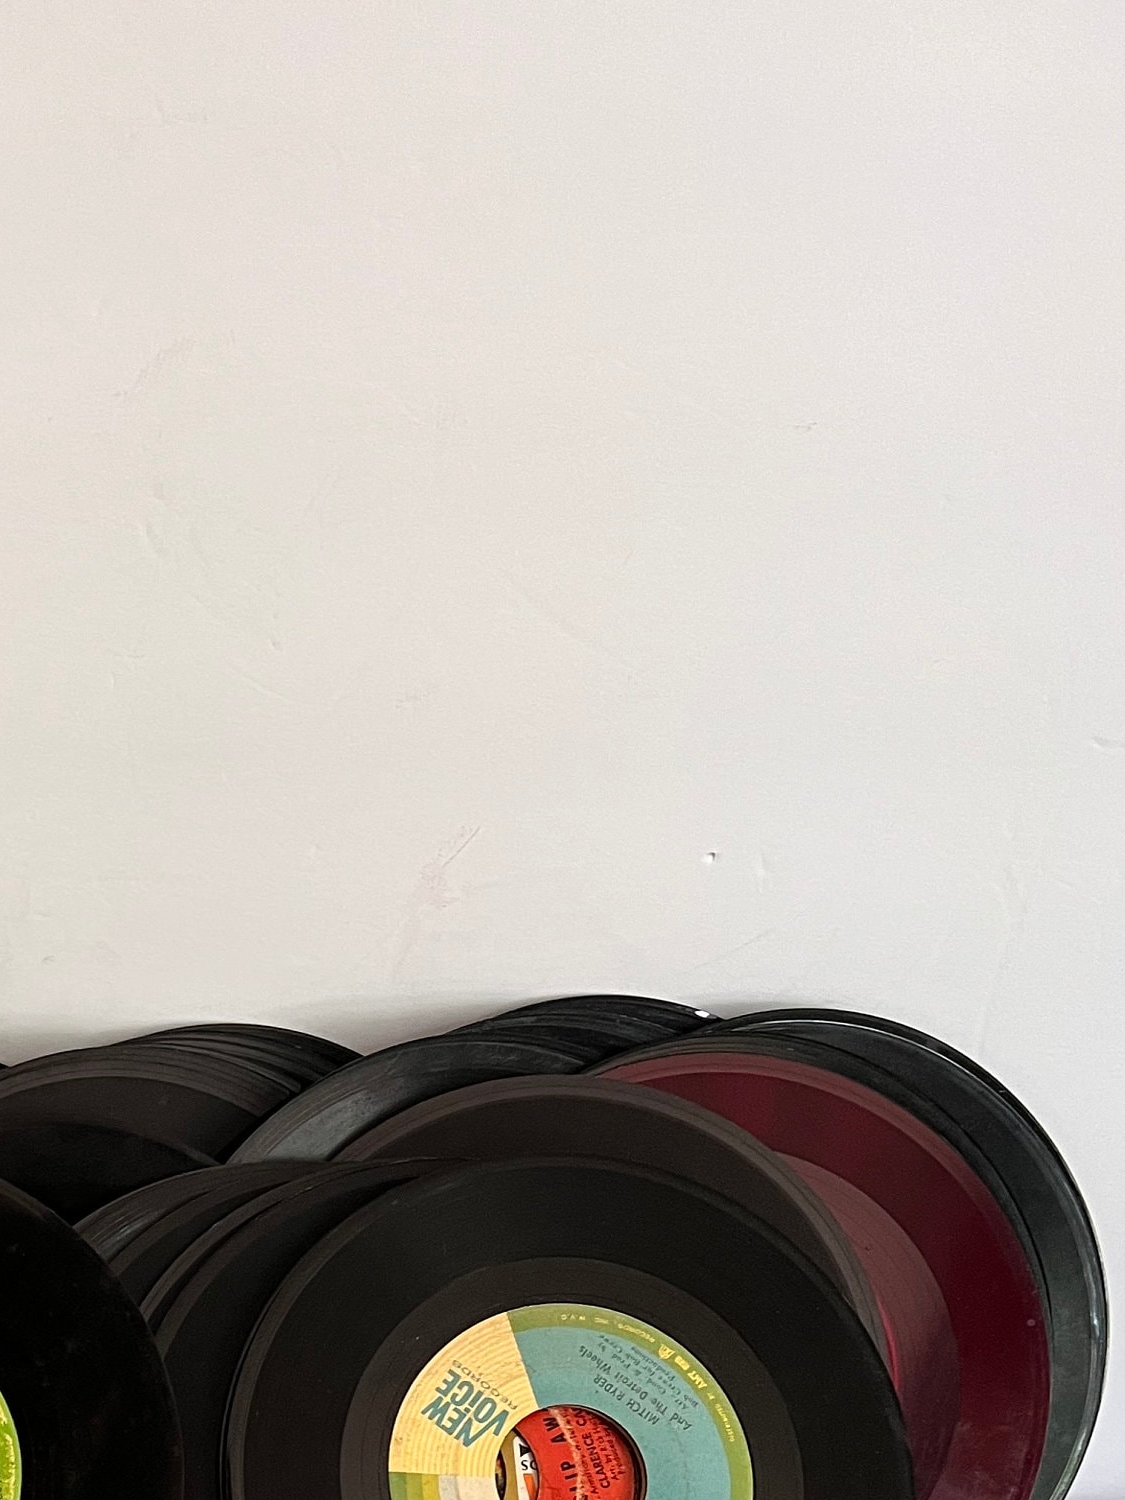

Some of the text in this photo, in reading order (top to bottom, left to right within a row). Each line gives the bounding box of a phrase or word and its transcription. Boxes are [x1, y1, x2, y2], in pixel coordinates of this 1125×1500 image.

[575, 1344, 692, 1431] And The Detroit Wheels
[591, 1373, 625, 1401] RYDER
[624, 1397, 660, 1425] MITCH
[420, 1392, 487, 1451] NEW
[581, 1432, 610, 1490] CLARENCE
